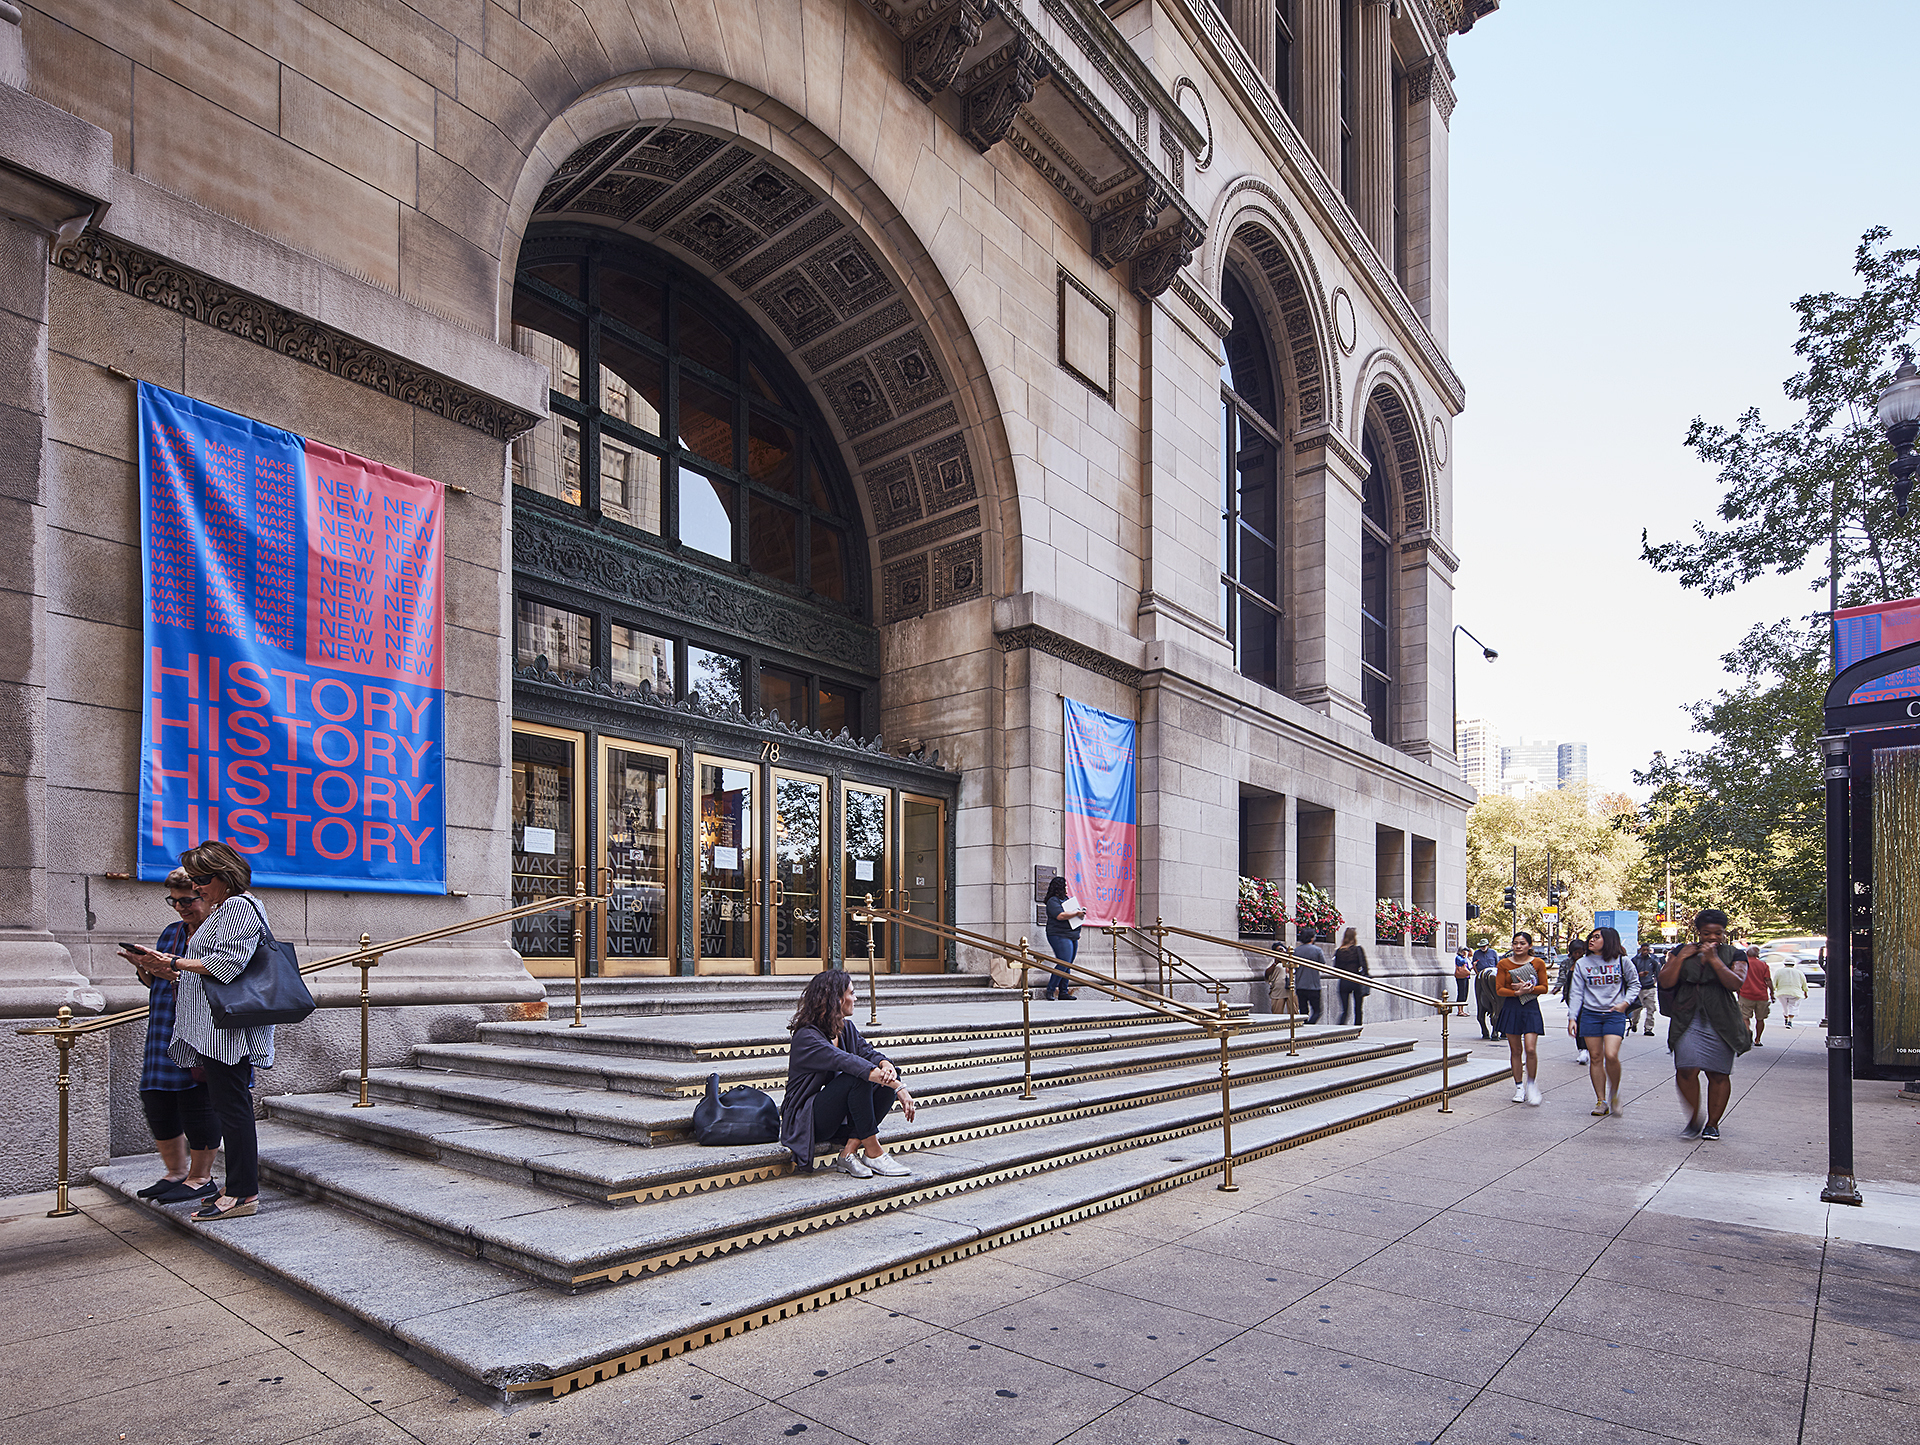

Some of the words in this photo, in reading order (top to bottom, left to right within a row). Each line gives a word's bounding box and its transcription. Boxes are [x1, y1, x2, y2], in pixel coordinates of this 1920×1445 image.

[152, 421, 195, 443] MAKE
[205, 439, 245, 460] MAKE
[255, 455, 295, 474] MAKE
[152, 434, 195, 455] MAKE
[205, 451, 245, 472] MAKE
[255, 467, 295, 486] MAKE
[152, 446, 195, 468] MAKE
[205, 463, 245, 484] MAKE
[255, 479, 295, 497] MAKE
[152, 460, 195, 480] MAKE
[205, 475, 246, 496] MAKE
[255, 490, 295, 508] MAKE
[152, 472, 195, 493] MAKE
[205, 487, 246, 507] MAKE
[255, 502, 295, 520] MAKE
[152, 485, 195, 506] MAKE
[205, 500, 246, 519] MAKE
[255, 514, 295, 532] MAKE
[318, 476, 372, 506] NEW
[384, 496, 434, 524] NEW
[152, 498, 195, 518] MAKE
[205, 513, 246, 531] MAKE
[255, 526, 295, 543] MAKE
[152, 511, 195, 530] MAKE
[205, 525, 246, 543] MAKE
[255, 538, 295, 555] MAKE
[319, 496, 373, 525] NEW
[385, 515, 434, 542] NEW
[320, 516, 374, 545] NEW
[386, 534, 434, 561] NEW
[152, 524, 195, 542] MAKE
[205, 537, 246, 555] MAKE
[255, 549, 295, 567] MAKE
[152, 536, 195, 554] MAKE
[206, 549, 246, 568] MAKE
[255, 562, 295, 579] MAKE
[321, 536, 375, 564] NEW
[385, 554, 433, 581] NEW
[152, 549, 195, 567] MAKE
[206, 561, 246, 580] MAKE
[255, 574, 295, 591] MAKE
[152, 562, 195, 579] MAKE
[206, 573, 246, 592] MAKE
[255, 586, 295, 603] MAKE
[321, 556, 374, 585] NEW
[384, 575, 433, 600] NEW
[152, 575, 195, 592] MAKE
[206, 586, 246, 604] MAKE
[255, 598, 295, 615] MAKE
[152, 587, 195, 604] MAKE
[206, 598, 246, 616] MAKE
[255, 610, 295, 626] MAKE
[321, 577, 374, 605] NEW
[384, 594, 433, 619] NEW
[152, 600, 195, 617] MAKE
[206, 610, 246, 628] MAKE
[255, 622, 294, 638] MAKE
[152, 612, 195, 630] MAKE
[206, 623, 246, 639] MAKE
[255, 634, 294, 650] MAKE
[320, 598, 373, 625] NEW
[385, 614, 433, 639] NEW
[320, 619, 373, 645] NEW
[385, 634, 433, 658] NEW
[319, 640, 374, 665] NEW
[386, 653, 433, 677] NEW
[152, 646, 434, 734] HISTORY
[152, 697, 434, 777] HISTORY
[1069, 717, 1109, 741] CHICAGO
[1069, 735, 1133, 764] ARCHITECTURE
[760, 740, 780, 763] 78
[1069, 751, 1111, 775] BIENNIAL
[152, 749, 434, 821] HISTORY
[152, 800, 434, 865] HISTORY
[1095, 835, 1133, 861] chicago
[511, 855, 568, 875] MAKE
[511, 876, 568, 894] MAKE
[1095, 860, 1133, 881] cultural
[1096, 884, 1125, 903] center
[511, 916, 568, 934] MAKE
[511, 936, 569, 953] MAKE
[607, 915, 652, 933] NEW
[607, 936, 652, 953] NEW
[1585, 964, 1620, 975] YOUTH
[1587, 974, 1620, 986] TRIBE
